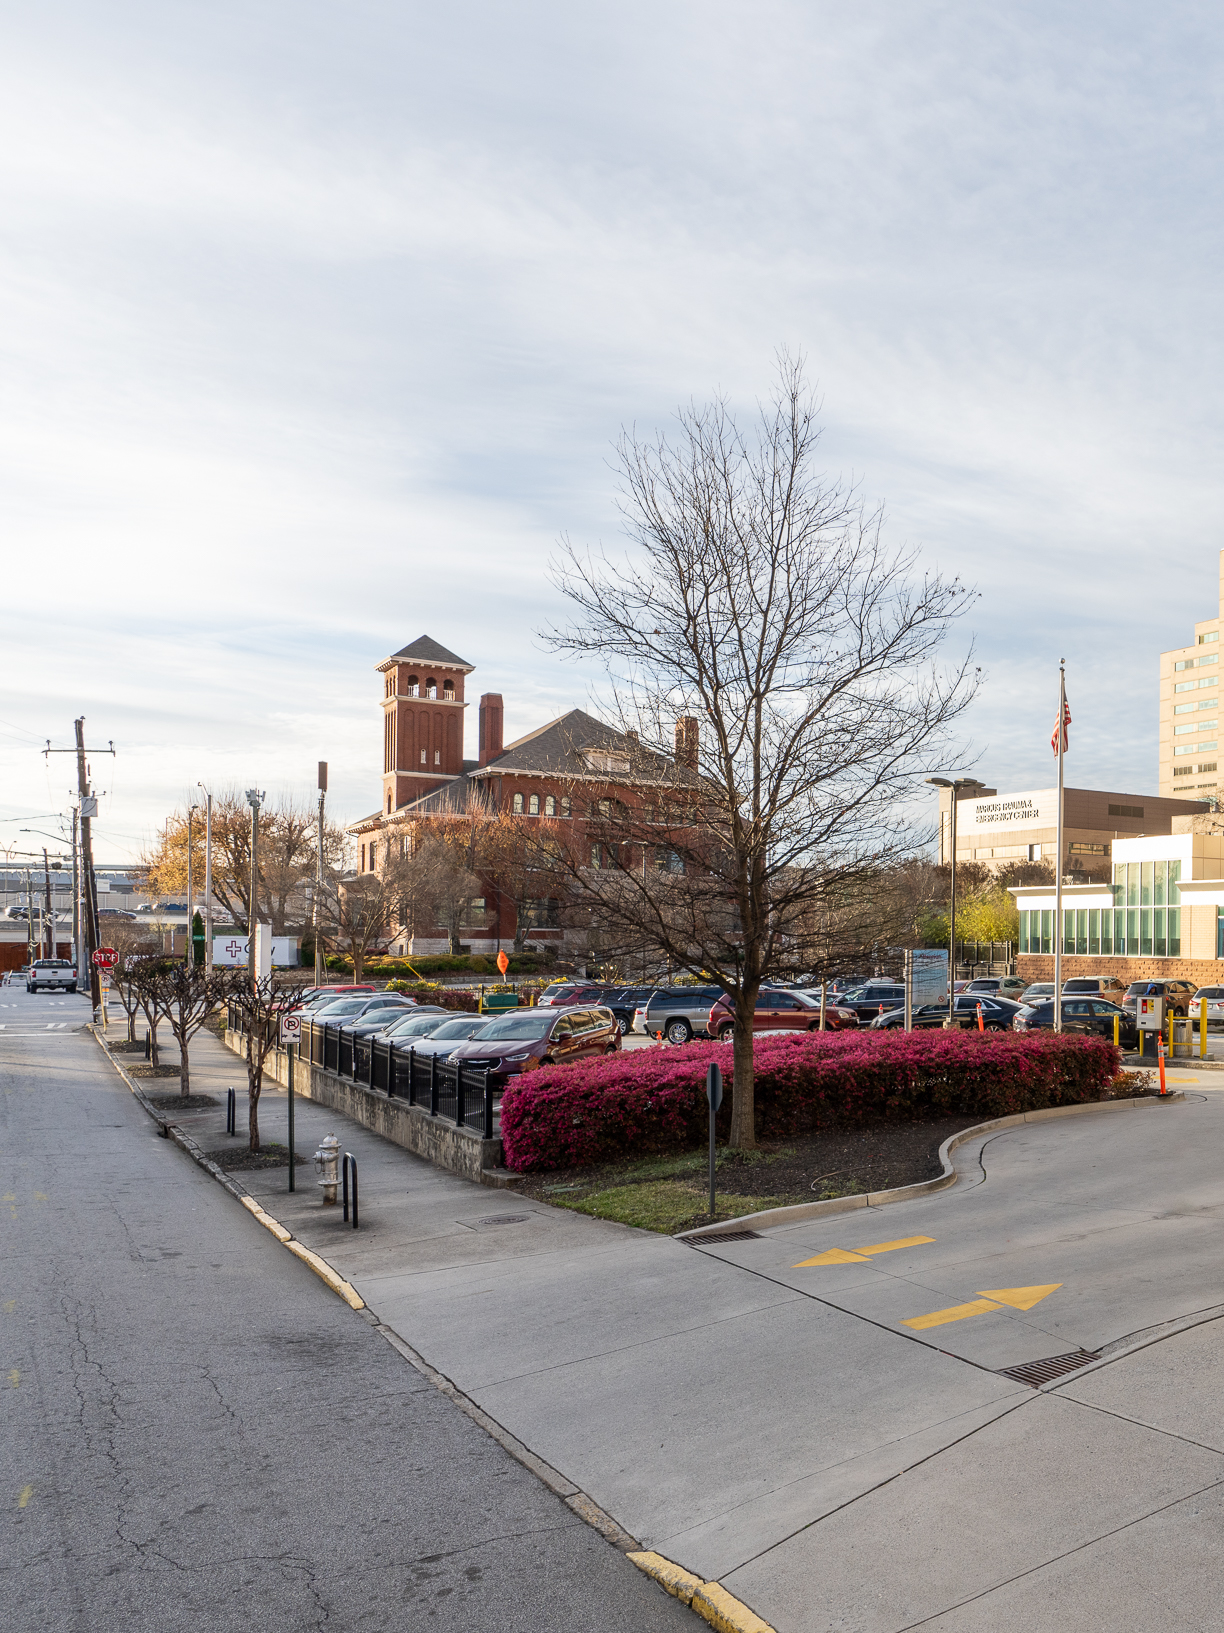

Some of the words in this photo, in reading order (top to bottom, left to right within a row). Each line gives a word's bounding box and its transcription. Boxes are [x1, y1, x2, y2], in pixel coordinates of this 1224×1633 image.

[976, 803, 1001, 813] MARCUS
[1002, 800, 1027, 811] TRAUMA
[976, 812, 1014, 823] EMERGENCY
[1014, 809, 1039, 819] CENTER
